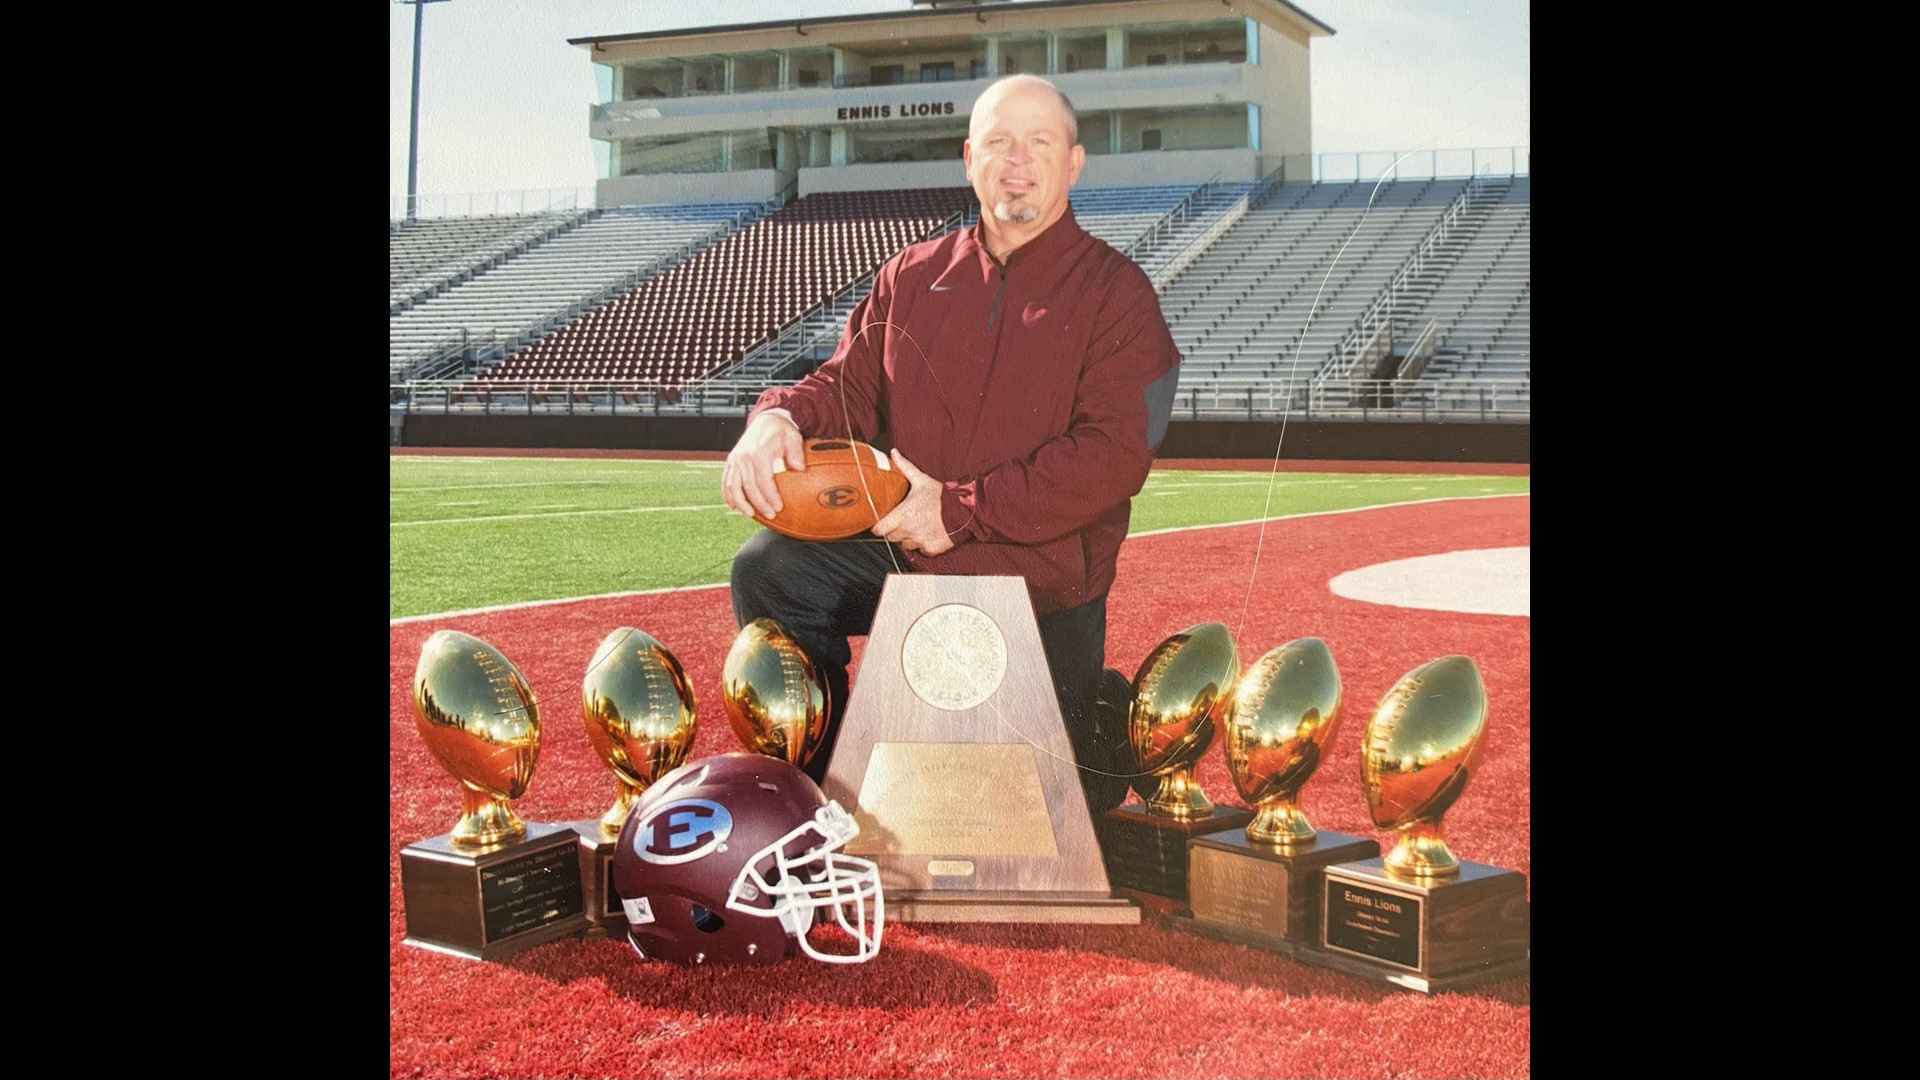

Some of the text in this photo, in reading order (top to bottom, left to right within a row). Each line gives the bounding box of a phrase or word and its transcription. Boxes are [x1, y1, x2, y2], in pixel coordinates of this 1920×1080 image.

[837, 101, 955, 120] ENNIS LIONS
[823, 487, 855, 507] E
[645, 804, 716, 857] E
[1344, 890, 1402, 914] Ennis Lions
